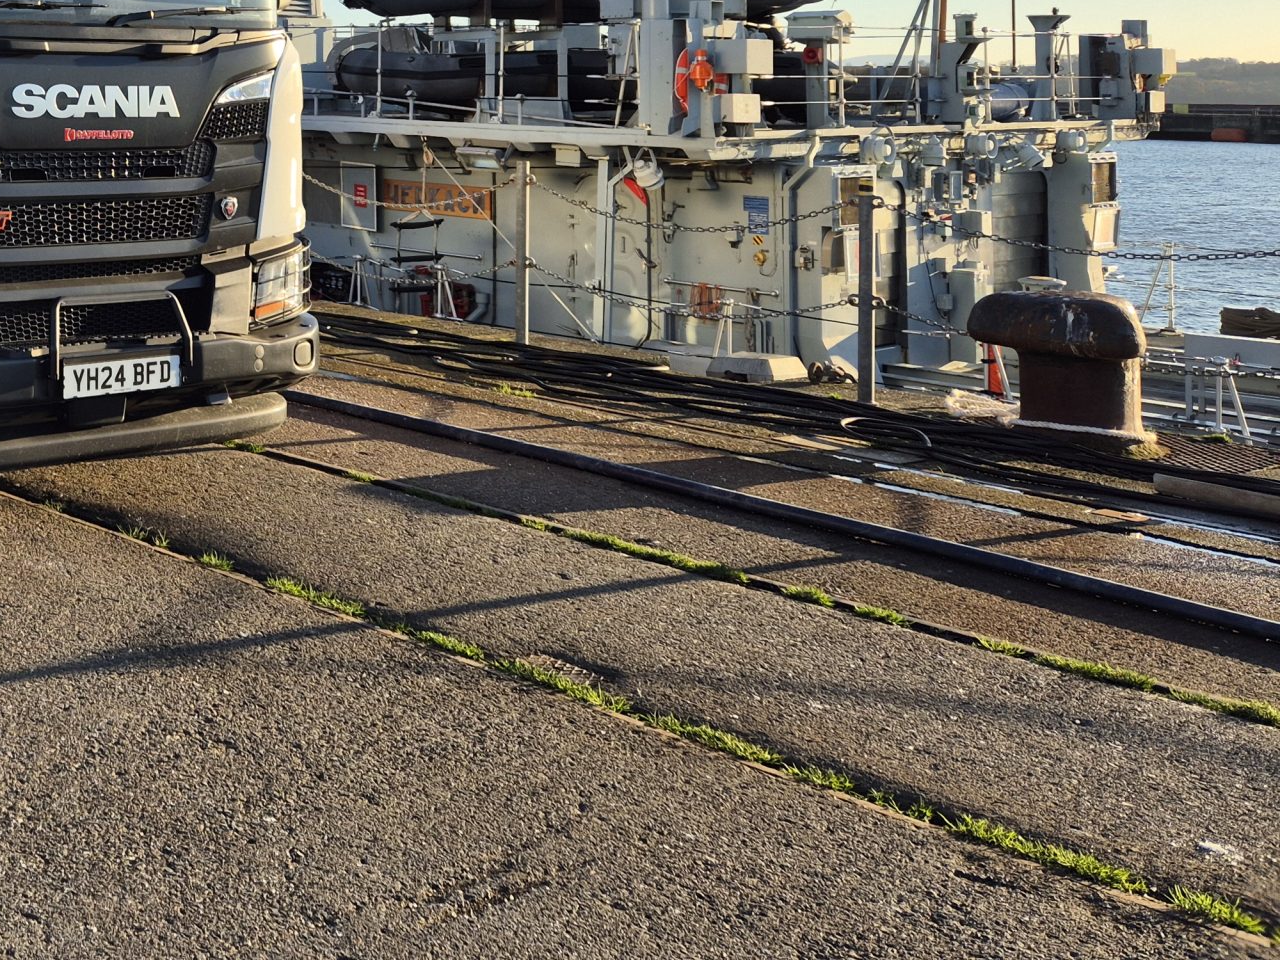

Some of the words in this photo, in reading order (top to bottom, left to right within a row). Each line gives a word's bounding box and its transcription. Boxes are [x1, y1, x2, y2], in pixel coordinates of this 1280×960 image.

[11, 83, 181, 119] SCANIA
[72, 364, 126, 392] YH24
[133, 360, 171, 386] BFD
